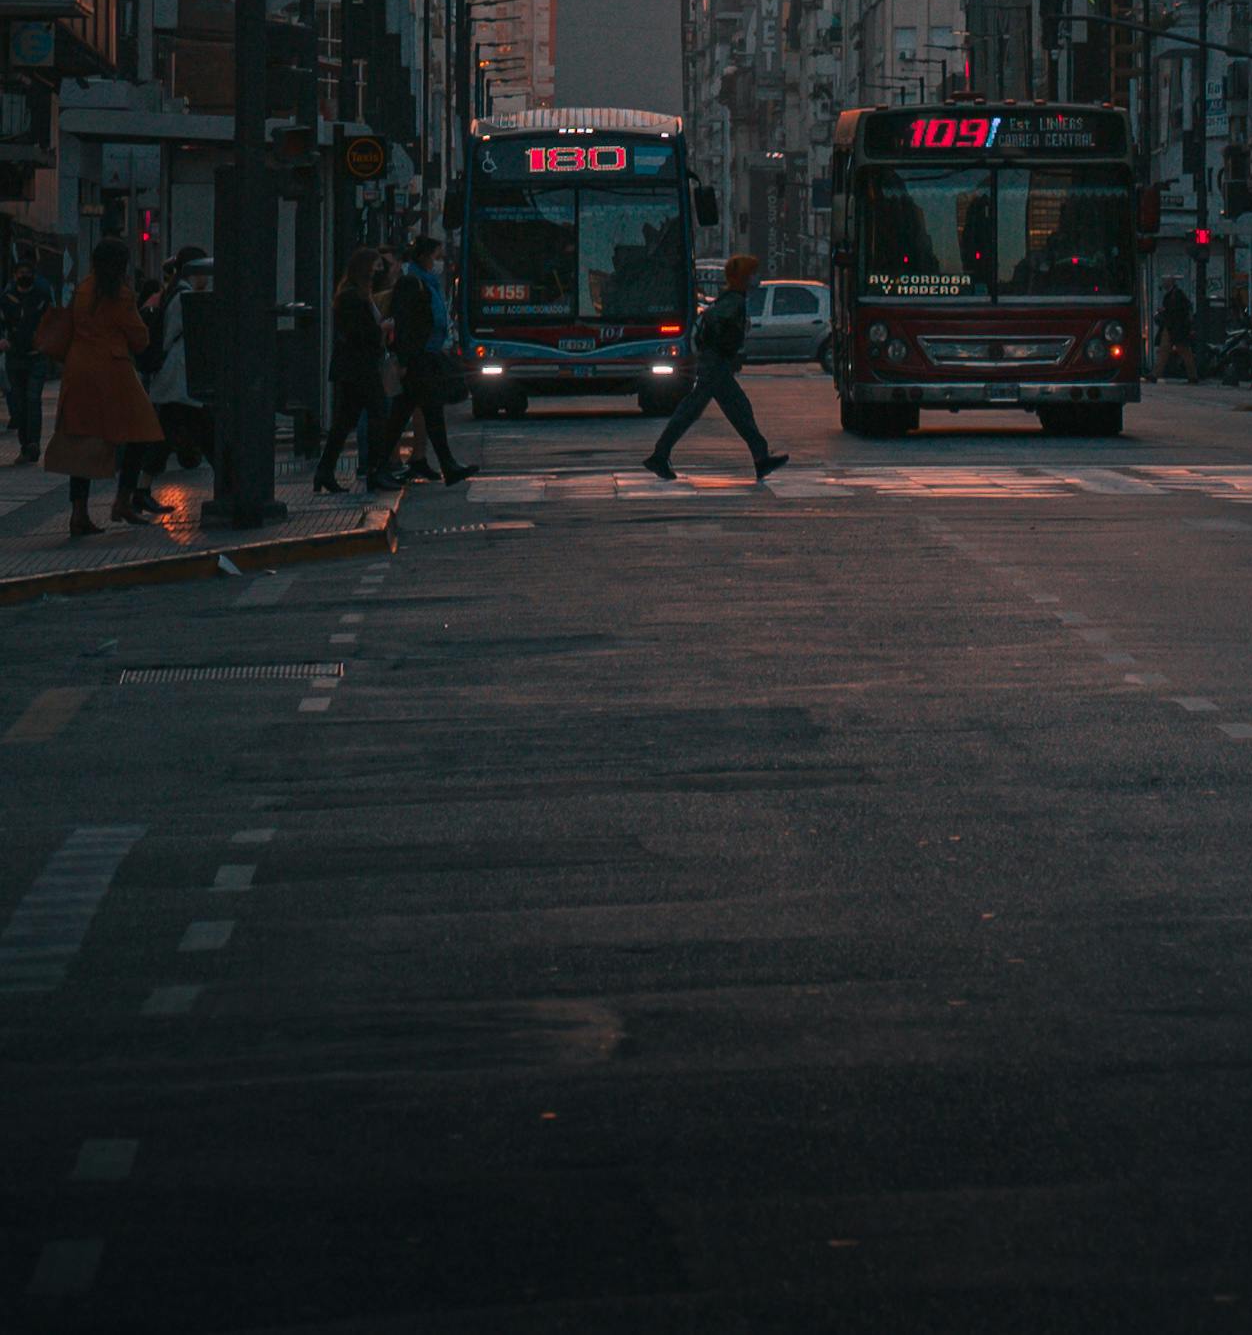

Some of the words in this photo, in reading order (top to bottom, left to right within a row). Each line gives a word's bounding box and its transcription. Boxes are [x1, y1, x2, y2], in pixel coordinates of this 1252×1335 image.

[525, 145, 627, 172] 180
[899, 274, 971, 285] CORDOBA
[882, 285, 893, 295] Y
[898, 285, 960, 295] MADERO
